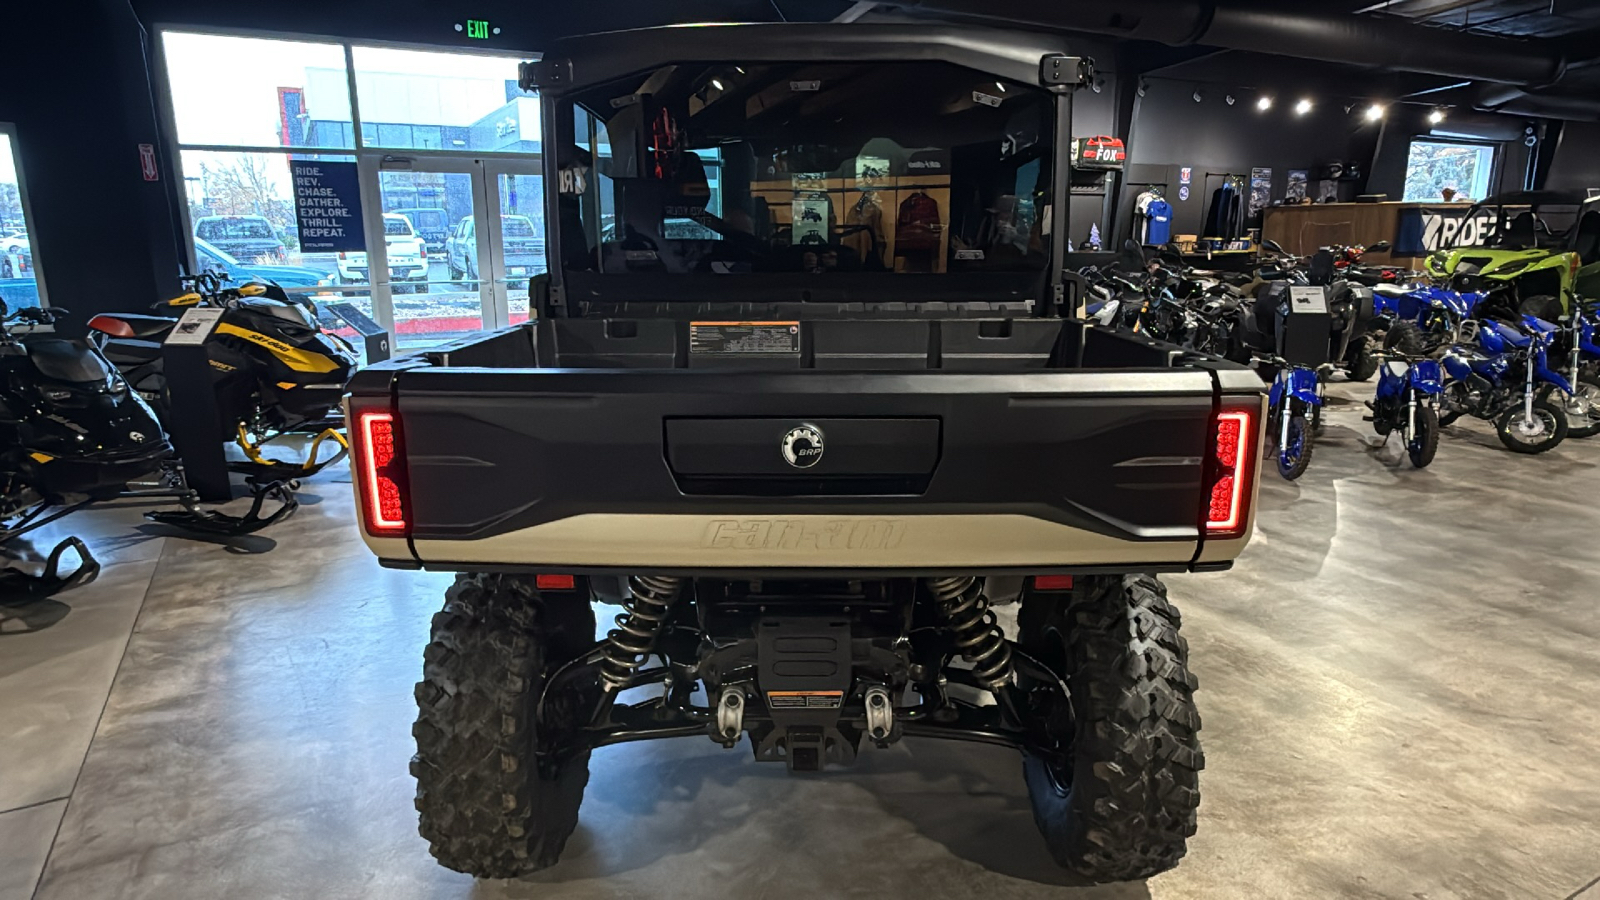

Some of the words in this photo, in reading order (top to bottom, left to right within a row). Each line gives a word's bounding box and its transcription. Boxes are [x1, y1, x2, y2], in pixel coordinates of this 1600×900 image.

[467, 20, 489, 39] EXIT
[1096, 149, 1117, 162] FOX
[295, 167, 323, 175] RIDE.
[297, 177, 320, 185] REV.
[298, 188, 336, 196] CHASE.
[299, 198, 343, 206] GATHER.
[301, 208, 351, 216] EXPLORE.
[301, 218, 341, 226] THRILL.
[303, 228, 345, 236] REPEAT.
[798, 448, 821, 456] BRP
